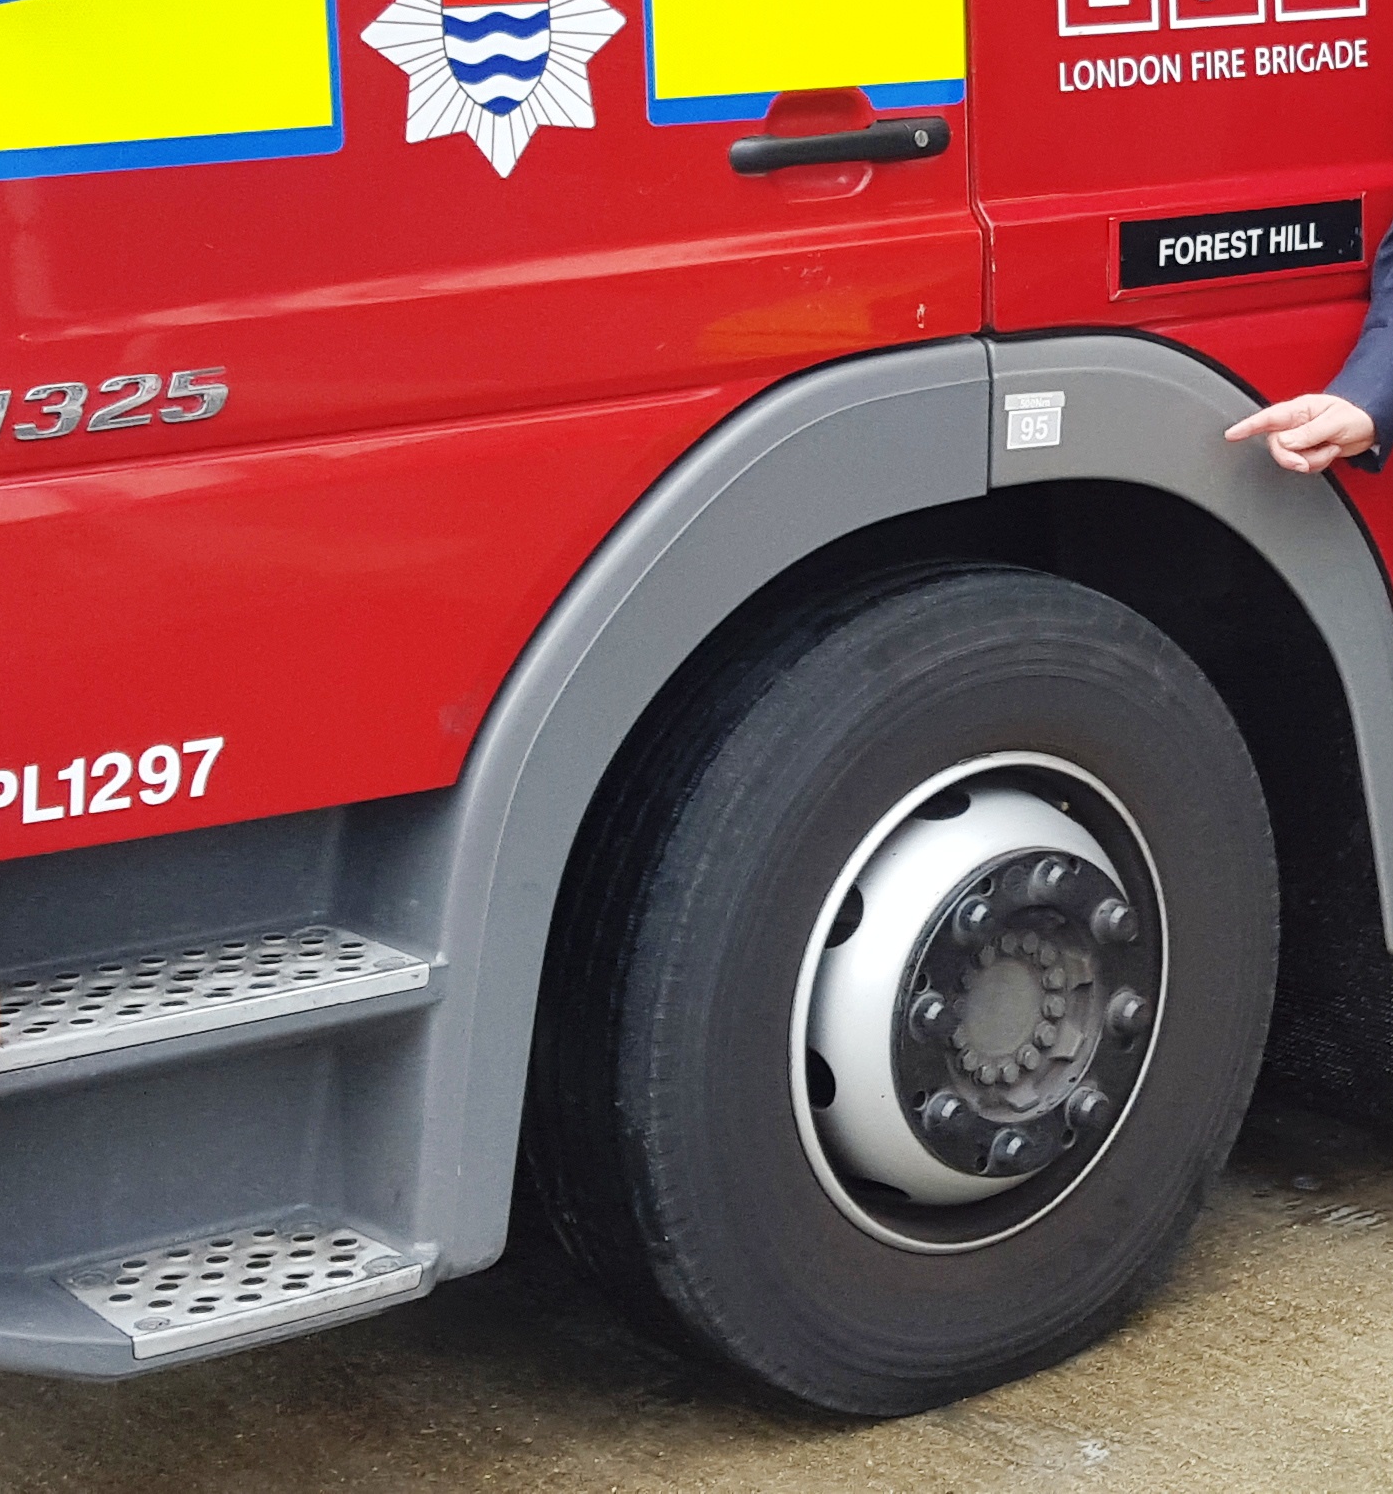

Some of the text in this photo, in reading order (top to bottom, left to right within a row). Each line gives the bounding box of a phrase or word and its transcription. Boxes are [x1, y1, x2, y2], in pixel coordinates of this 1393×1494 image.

[1059, 39, 1369, 92] LONDON FIRE BRIGADE
[1158, 222, 1324, 266] FOREST HILL
[1020, 415, 1049, 442] 95
